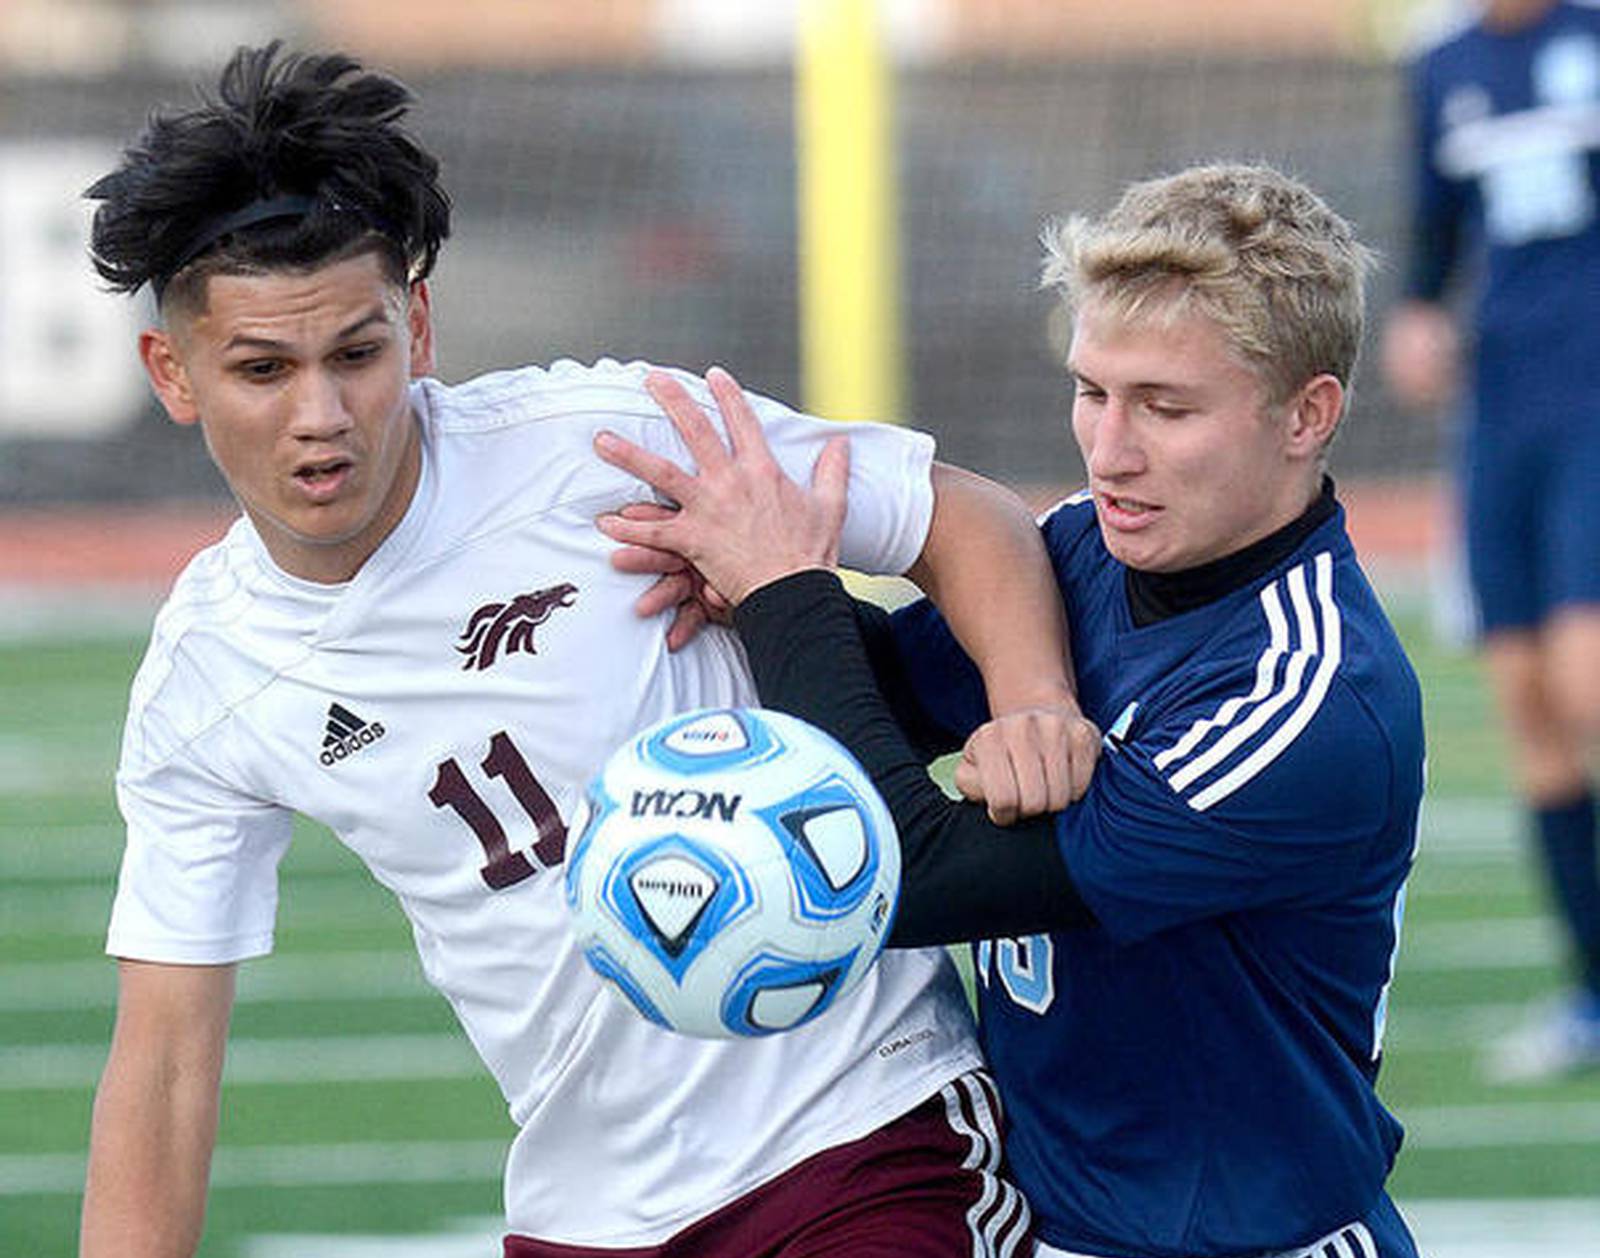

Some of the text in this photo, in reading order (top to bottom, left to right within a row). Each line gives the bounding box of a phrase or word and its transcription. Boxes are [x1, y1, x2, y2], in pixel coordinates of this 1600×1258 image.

[319, 721, 386, 767] adidas
[427, 730, 570, 891] 11
[629, 788, 742, 822] NCAA
[637, 877, 704, 899] Wilson
